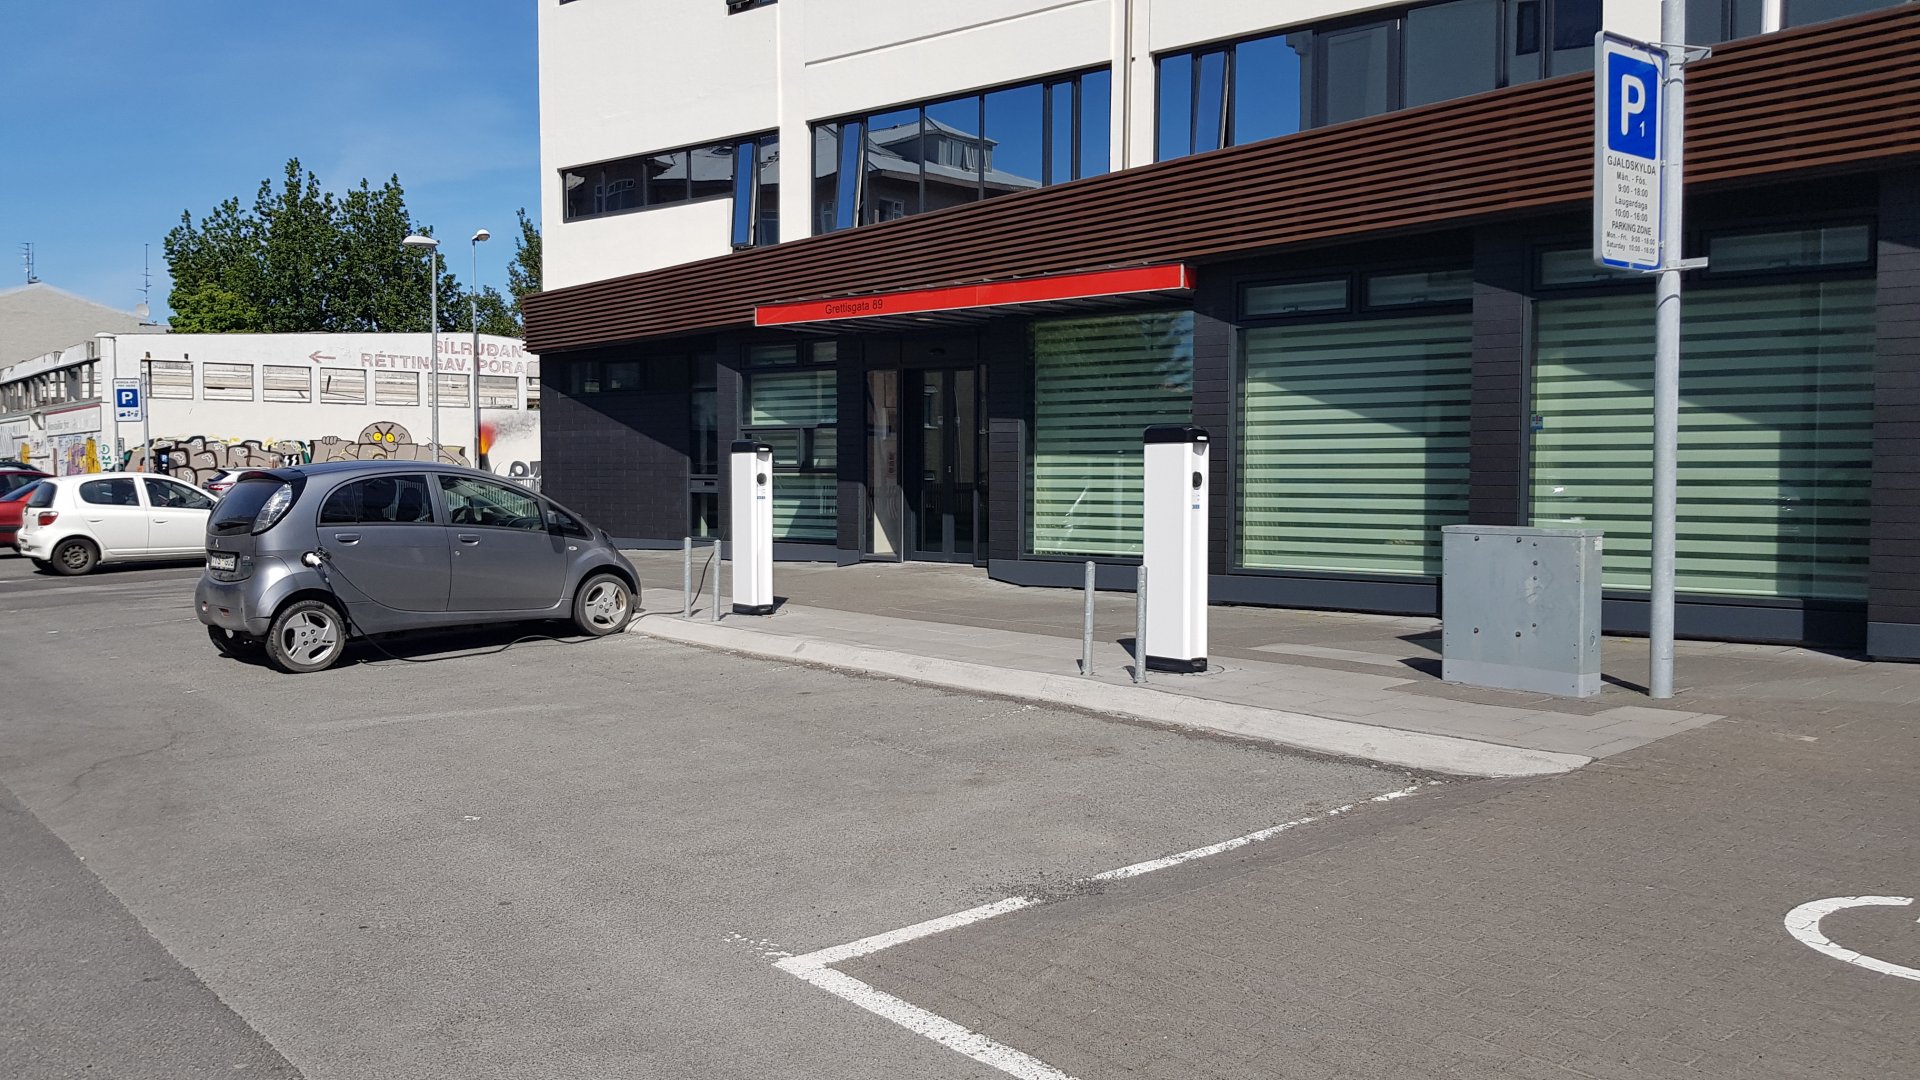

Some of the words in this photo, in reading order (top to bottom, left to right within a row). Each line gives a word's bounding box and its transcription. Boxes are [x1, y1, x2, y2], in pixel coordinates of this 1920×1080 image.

[1621, 74, 1646, 135] P
[1639, 121, 1645, 137] 1
[1607, 155, 1656, 175] GJALDSKYLDA
[1618, 184, 1630, 194] 9:00
[1634, 188, 1649, 198] 18:00
[1615, 195, 1648, 211] Laugardaga
[1615, 209, 1630, 219] 10:00
[1612, 220, 1636, 233] PARKING
[1637, 224, 1652, 236] ZONE
[825, 302, 869, 315] Grettisgata
[872, 299, 883, 310] 89
[122, 392, 133, 405] P
